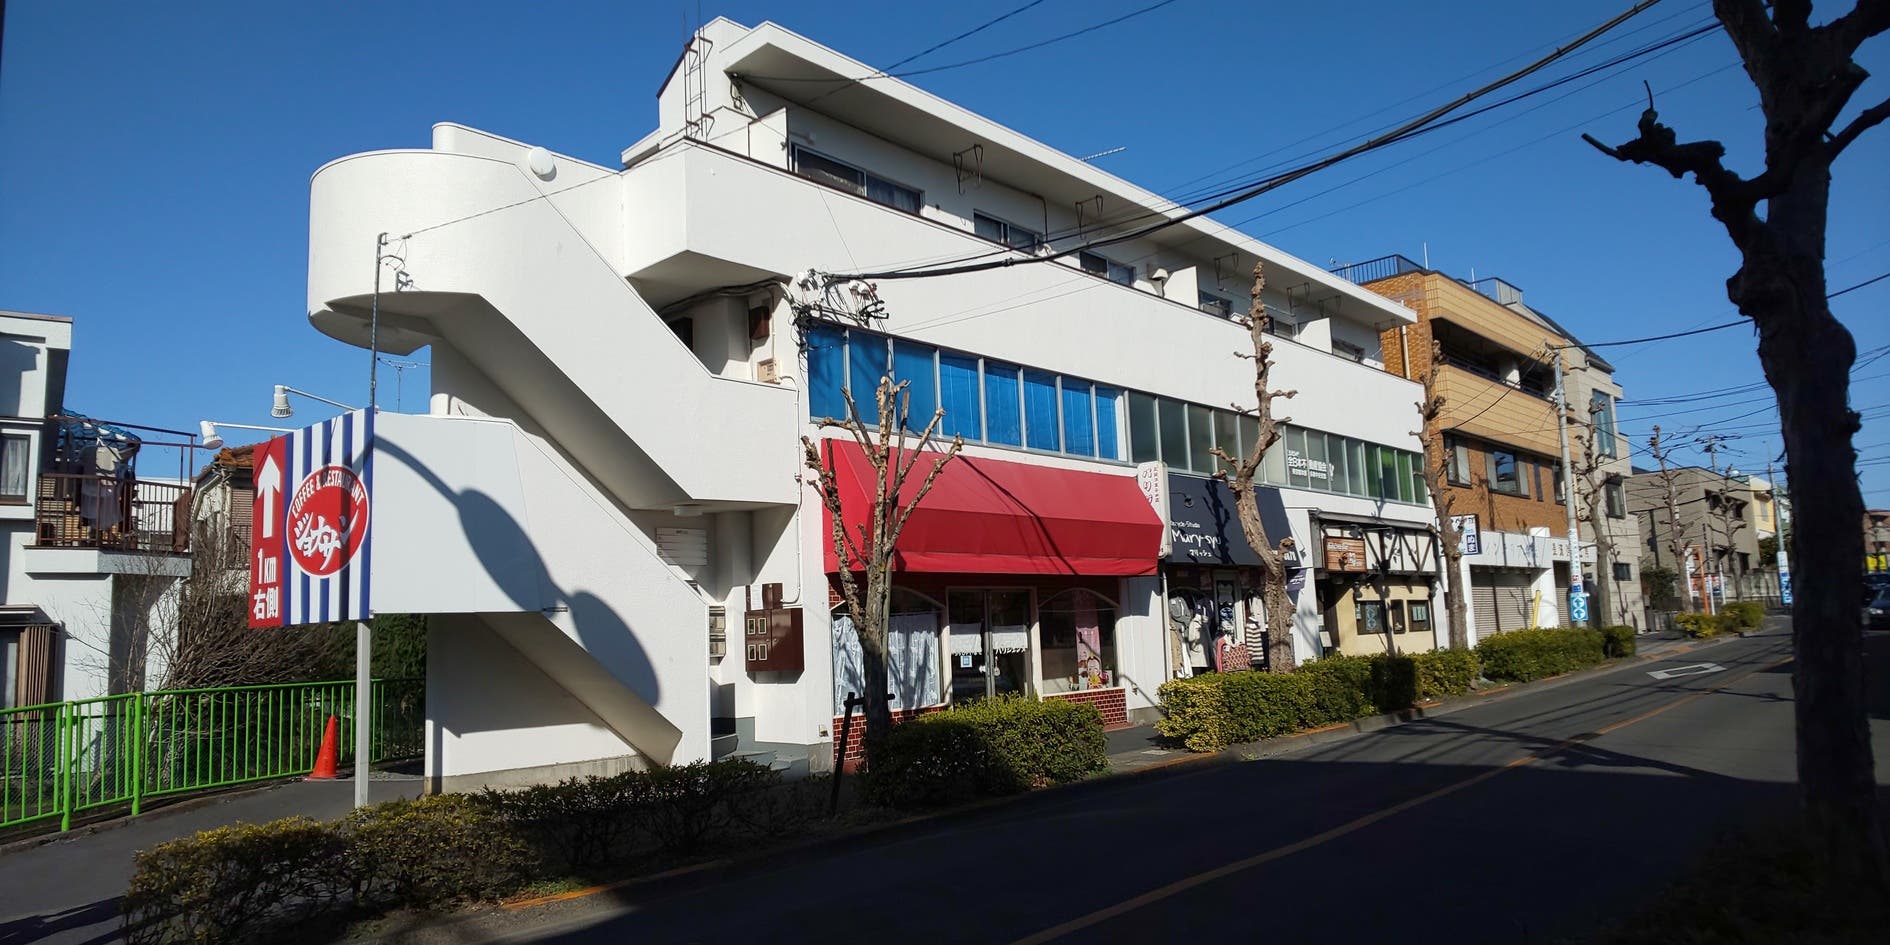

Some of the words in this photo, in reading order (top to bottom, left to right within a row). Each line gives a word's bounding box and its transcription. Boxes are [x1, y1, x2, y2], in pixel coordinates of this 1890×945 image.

[291, 478, 316, 519] COFFEE
[316, 474, 322, 491] &
[322, 470, 365, 507] RESTAURANT
[293, 509, 360, 571] ジョナサン
[253, 586, 279, 620] 右側
